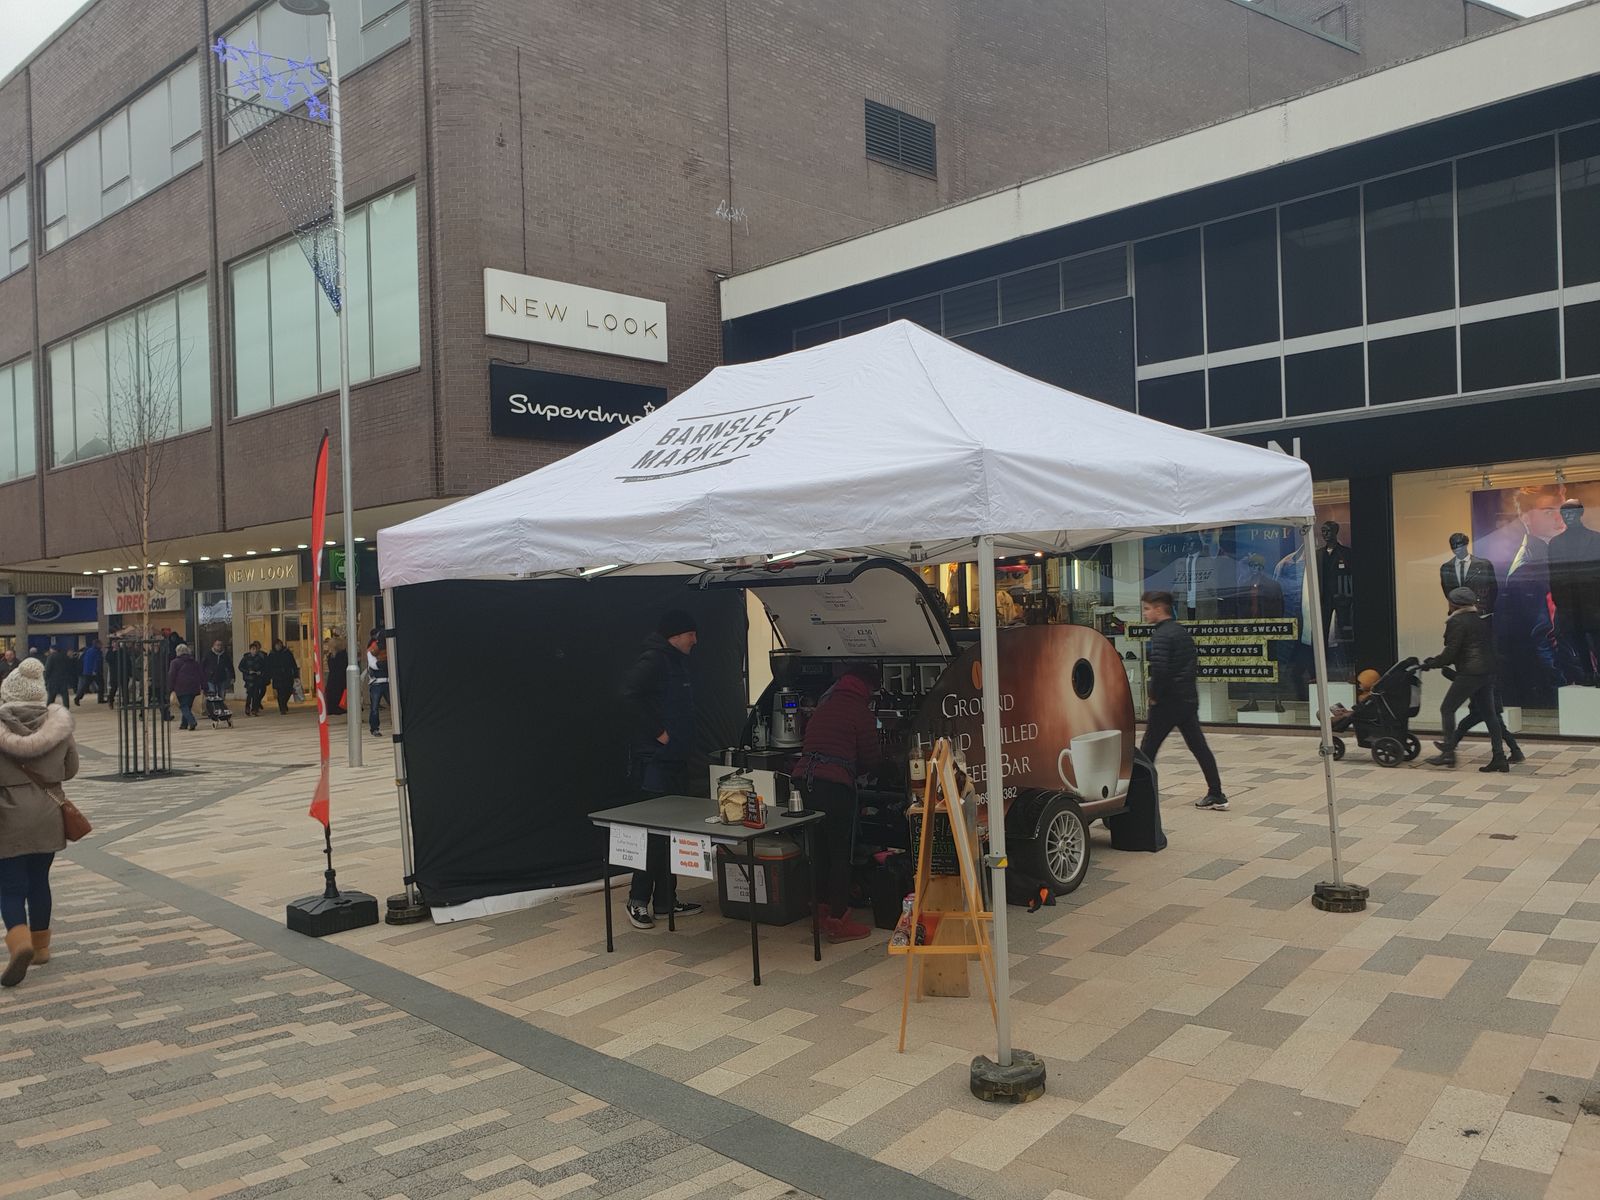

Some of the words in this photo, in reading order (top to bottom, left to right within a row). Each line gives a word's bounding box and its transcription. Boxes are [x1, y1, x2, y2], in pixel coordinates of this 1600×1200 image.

[500, 294, 568, 323] NEW
[586, 309, 659, 340] LOOK
[656, 406, 802, 446] BARNSLEY
[631, 428, 776, 470] MARKETS
[228, 568, 255, 583] NEW
[260, 563, 295, 581] LOOK
[116, 574, 154, 593] SPORS
[1201, 626, 1239, 634] HOODIES
[1252, 624, 1289, 633] SWEATS
[1230, 646, 1259, 654] COATS
[1202, 667, 1219, 675] OFF
[1222, 666, 1270, 676] KNITWEAR
[1001, 753, 1032, 778] BAR
